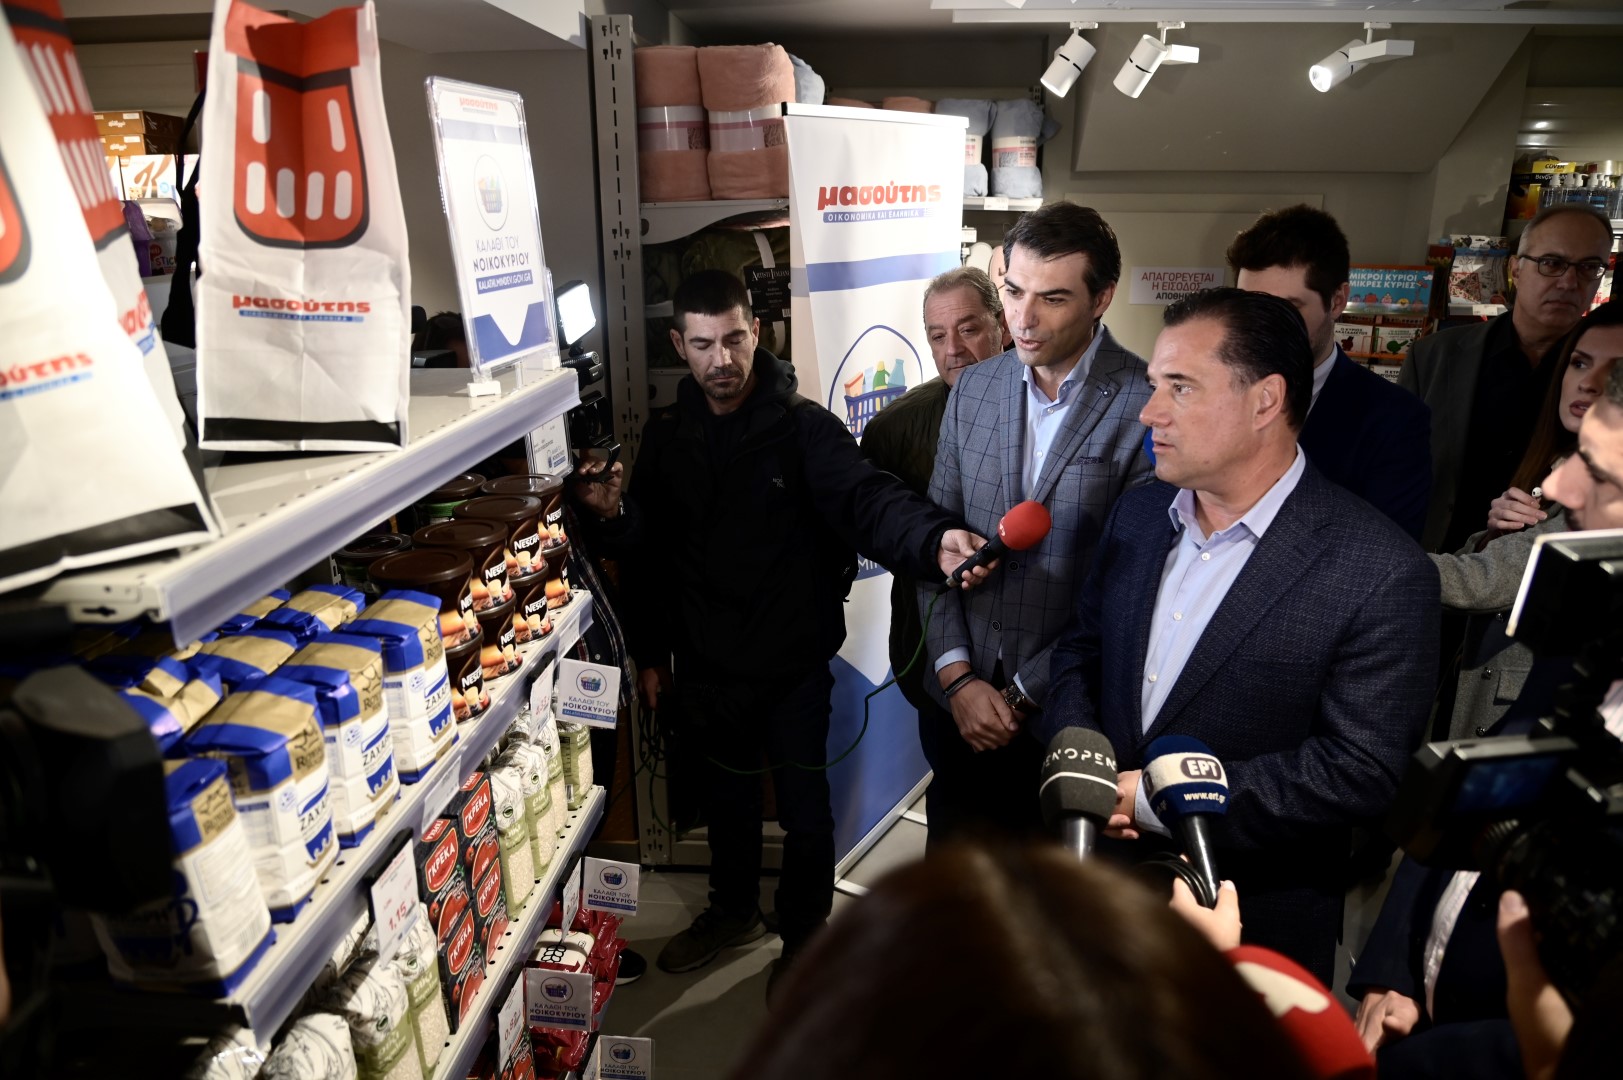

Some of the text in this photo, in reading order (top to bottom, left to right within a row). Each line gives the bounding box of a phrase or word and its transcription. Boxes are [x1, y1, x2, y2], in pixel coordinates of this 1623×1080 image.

[817, 180, 942, 211] μασούτης
[827, 211, 876, 222] ΟΙΚΟΝΟΜΙΚΑ
[475, 236, 519, 252] ΚΑΛΑΘΙ ΤΟΥ
[473, 252, 529, 272] ΝΟΙΚΟΚΥΡΙΟΥ
[1141, 272, 1215, 282] ΑΠΑΓΟΡΕΥΕΤΑΙ
[1349, 272, 1417, 282] ΜΙΚΡΟΙ ΚΥΡΙΟΙ
[1152, 282, 1202, 292] Η ΕΙΣΟΔΟΣ
[1349, 280, 1416, 289] ΜΙΚΡΕΣ ΚΥΡΙΕΣ
[232, 295, 371, 313] μασούτης
[568, 695, 594, 705] ΚΑΛΑΘΙ
[562, 702, 616, 715] ΝΟΙΚΟΚΥΡΙΟΥ
[1064, 748, 1117, 771] OPEN
[1186, 760, 1218, 777] ΕΡΤ
[1183, 792, 1226, 804] www.ert.gr
[427, 842, 456, 884] ΓΚΡΕΚΑ
[588, 894, 637, 905] ΝΟΙΚΟΚΥΡΙΟΥ
[450, 923, 472, 968] ΓΚΡΕΚΑ
[534, 1003, 562, 1011] ΚΑΛΑΘΙ
[529, 1009, 586, 1018] ΝΟΙΚΟΚΥΡΙΟΥ
